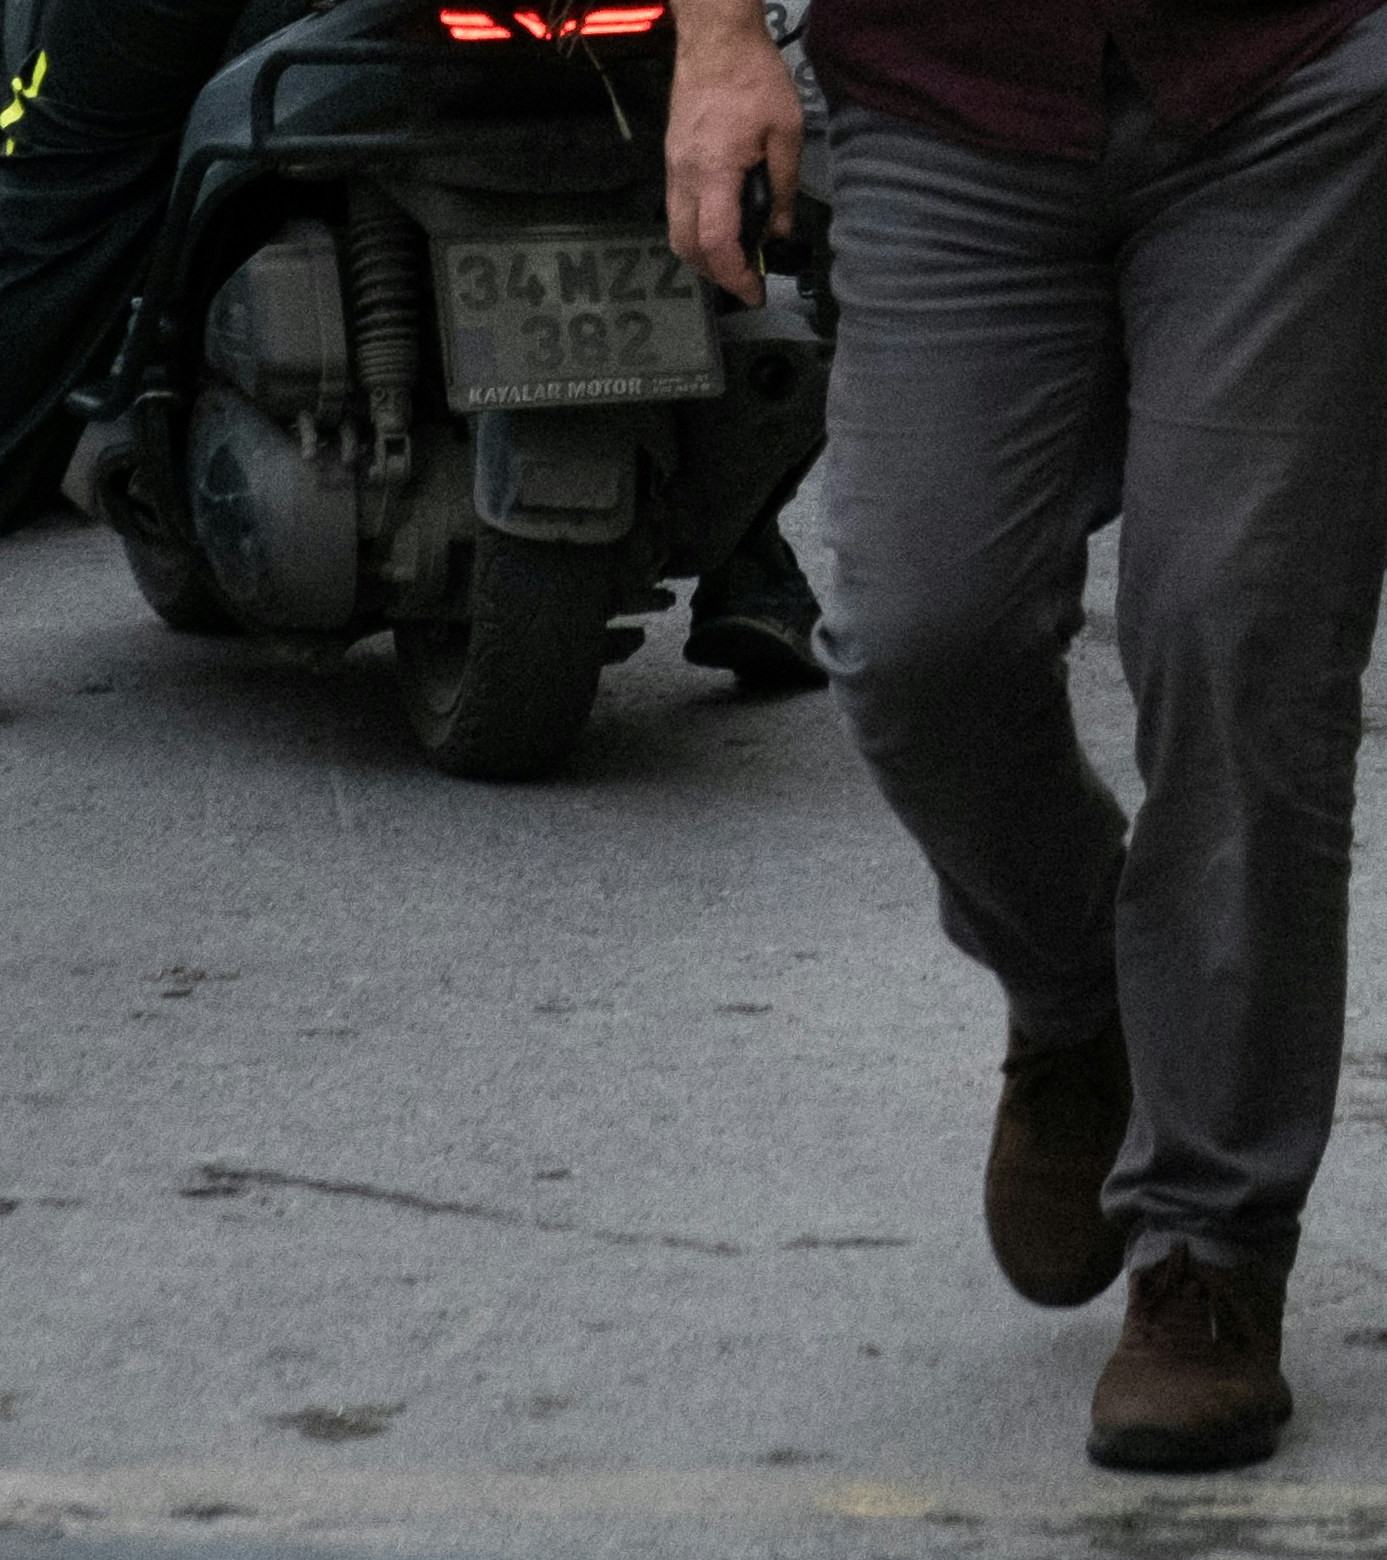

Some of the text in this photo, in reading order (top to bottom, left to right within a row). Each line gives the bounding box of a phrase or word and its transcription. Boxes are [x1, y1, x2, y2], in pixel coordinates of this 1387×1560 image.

[456, 252, 546, 312] 34
[521, 311, 661, 371] 382
[469, 381, 562, 405] KAYALAR
[567, 376, 642, 397] MOTOR
